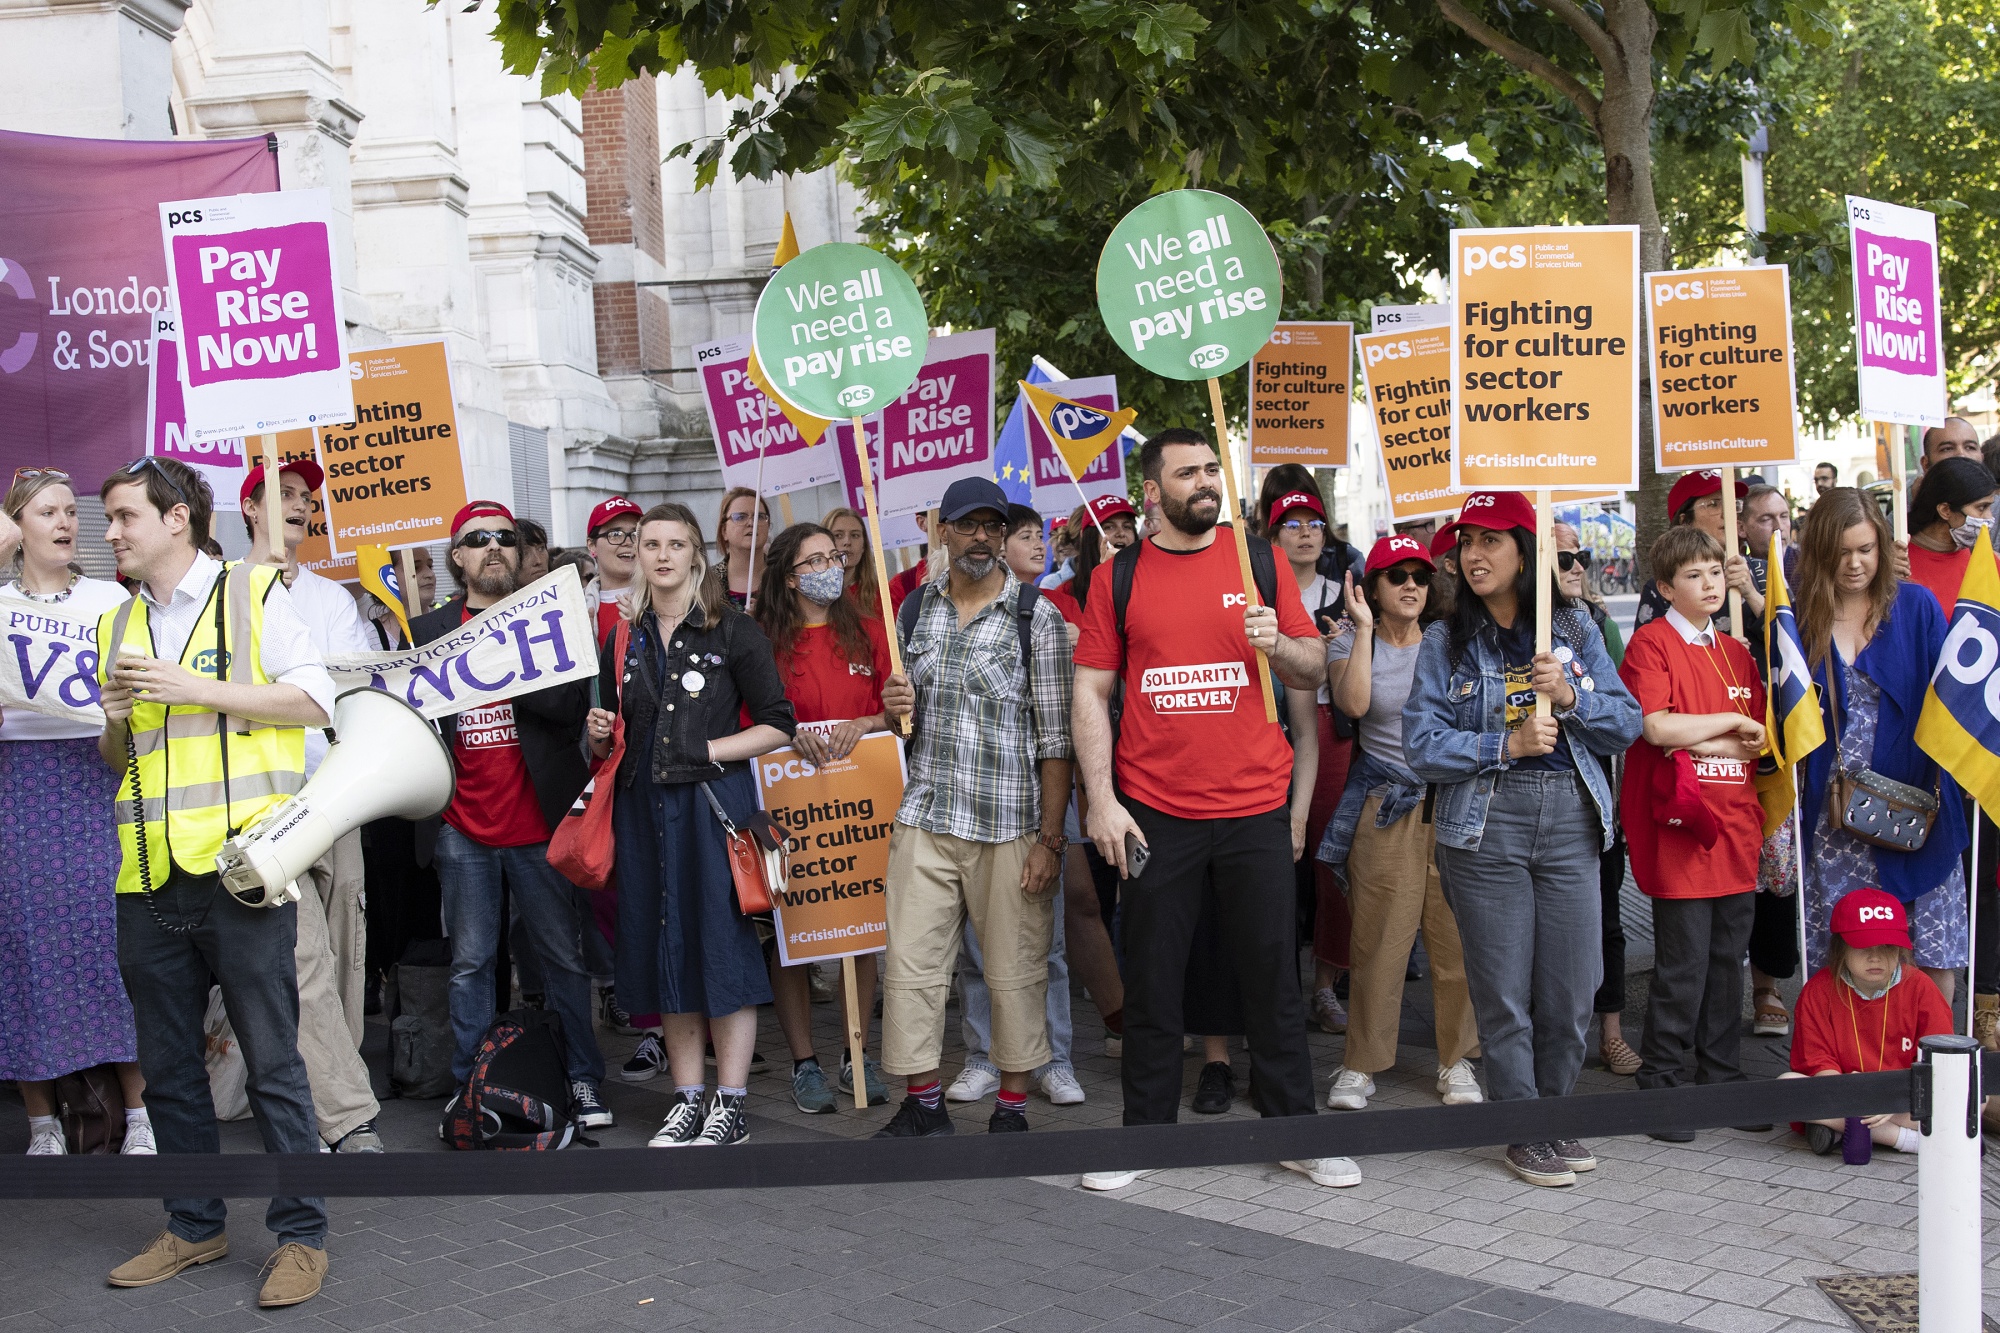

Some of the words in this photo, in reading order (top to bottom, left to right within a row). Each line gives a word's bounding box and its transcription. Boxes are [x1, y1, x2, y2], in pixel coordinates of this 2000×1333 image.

[168, 209, 203, 228] pcs
[1853, 206, 1870, 221] pcs
[1125, 234, 1183, 270] We
[1187, 214, 1232, 255] all
[199, 246, 281, 288] Pay
[1464, 244, 1527, 276] pcs
[1535, 252, 1574, 260] Commercial
[1535, 261, 1561, 269] Services
[1867, 243, 1909, 291] Pay
[785, 281, 838, 312] We
[842, 268, 883, 301] all
[1135, 254, 1218, 306] need
[1224, 256, 1245, 281] a
[1655, 280, 1704, 307] pcs
[1874, 285, 1922, 325] Rise
[216, 286, 309, 327] Rise
[1465, 300, 1592, 332] Fighting
[791, 303, 868, 345] need
[875, 306, 893, 329] a
[1129, 304, 1193, 351] pay
[1199, 286, 1267, 325] rise
[1377, 313, 1402, 325] pcs
[1464, 334, 1509, 358] for
[1515, 332, 1626, 357] culture
[1659, 321, 1757, 348] Fighting
[1865, 321, 1926, 363] Now!
[53, 331, 80, 370] &
[197, 323, 318, 371] Now!
[698, 346, 722, 362] pcs
[1193, 347, 1225, 366] pcs
[1366, 340, 1412, 367] pcs
[1659, 350, 1694, 369] for
[1699, 346, 1783, 366] culture
[370, 363, 401, 371] Commercial
[784, 347, 843, 387] pay
[850, 335, 912, 366] rise
[1256, 362, 1327, 379] Fighting
[371, 371, 391, 379] Services
[392, 368, 408, 376] Union
[1465, 367, 1563, 390] sector
[1661, 373, 1737, 394] sector
[842, 388, 871, 407] pcs
[900, 374, 957, 405] Pay
[1256, 379, 1280, 393] for
[1283, 380, 1345, 394] culture
[1255, 398, 1310, 411] sector
[1378, 407, 1410, 425] for
[1464, 397, 1590, 422] workers
[1662, 396, 1760, 418] workers
[908, 404, 971, 436] Rise
[1055, 407, 1106, 440] pcs
[1255, 415, 1325, 429] workers
[324, 434, 359, 454] for
[364, 423, 451, 449] culture
[892, 428, 974, 468] Now!
[1384, 425, 1451, 448] sector
[1664, 437, 1768, 453] #CrisisInCulture
[1254, 445, 1329, 456] #CrisisInCulture
[1464, 452, 1597, 468] #CrisisInCulture
[329, 454, 405, 478] sector
[331, 476, 431, 503] workers
[1282, 494, 1309, 507] pcs
[605, 499, 632, 511] pcs
[1096, 496, 1121, 510] pcs
[1464, 495, 1495, 512] pcs
[338, 516, 443, 539] #CrisisInCulture
[1389, 537, 1419, 551] pcs
[1222, 593, 1247, 608] pc
[1145, 667, 1241, 688] SOLIDARITY
[1154, 690, 1232, 709] FOREVER
[1728, 686, 1751, 700] pcs
[763, 757, 816, 788] pcs
[843, 764, 859, 772] Union
[771, 798, 874, 831] Fighting
[788, 833, 811, 853] or
[788, 854, 858, 880] ector
[1859, 906, 1894, 923] pcs
